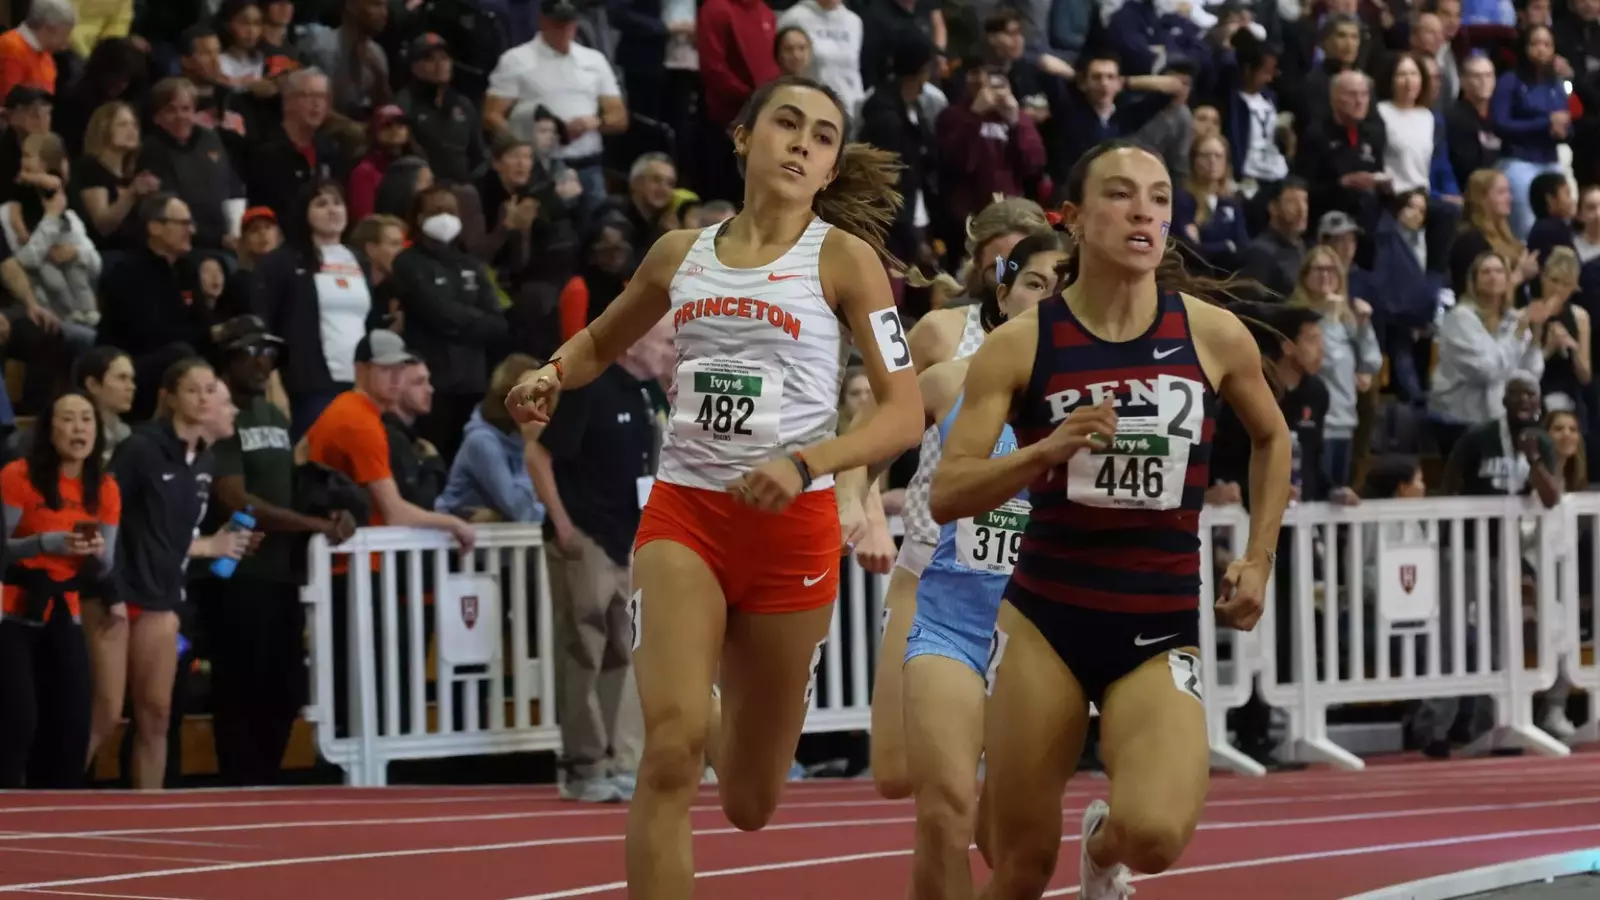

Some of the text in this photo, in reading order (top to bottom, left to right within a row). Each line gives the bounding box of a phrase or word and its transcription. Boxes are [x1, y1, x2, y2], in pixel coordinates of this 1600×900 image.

[674, 296, 801, 340] PRINCETON
[881, 312, 910, 366] 3
[710, 375, 731, 392] Ivy
[1045, 379, 1205, 423] PEN
[694, 394, 755, 435] 482
[1167, 381, 1193, 439] 2
[1095, 456, 1163, 498] 446
[988, 511, 1008, 526] Ivy
[973, 527, 1023, 566] 319
